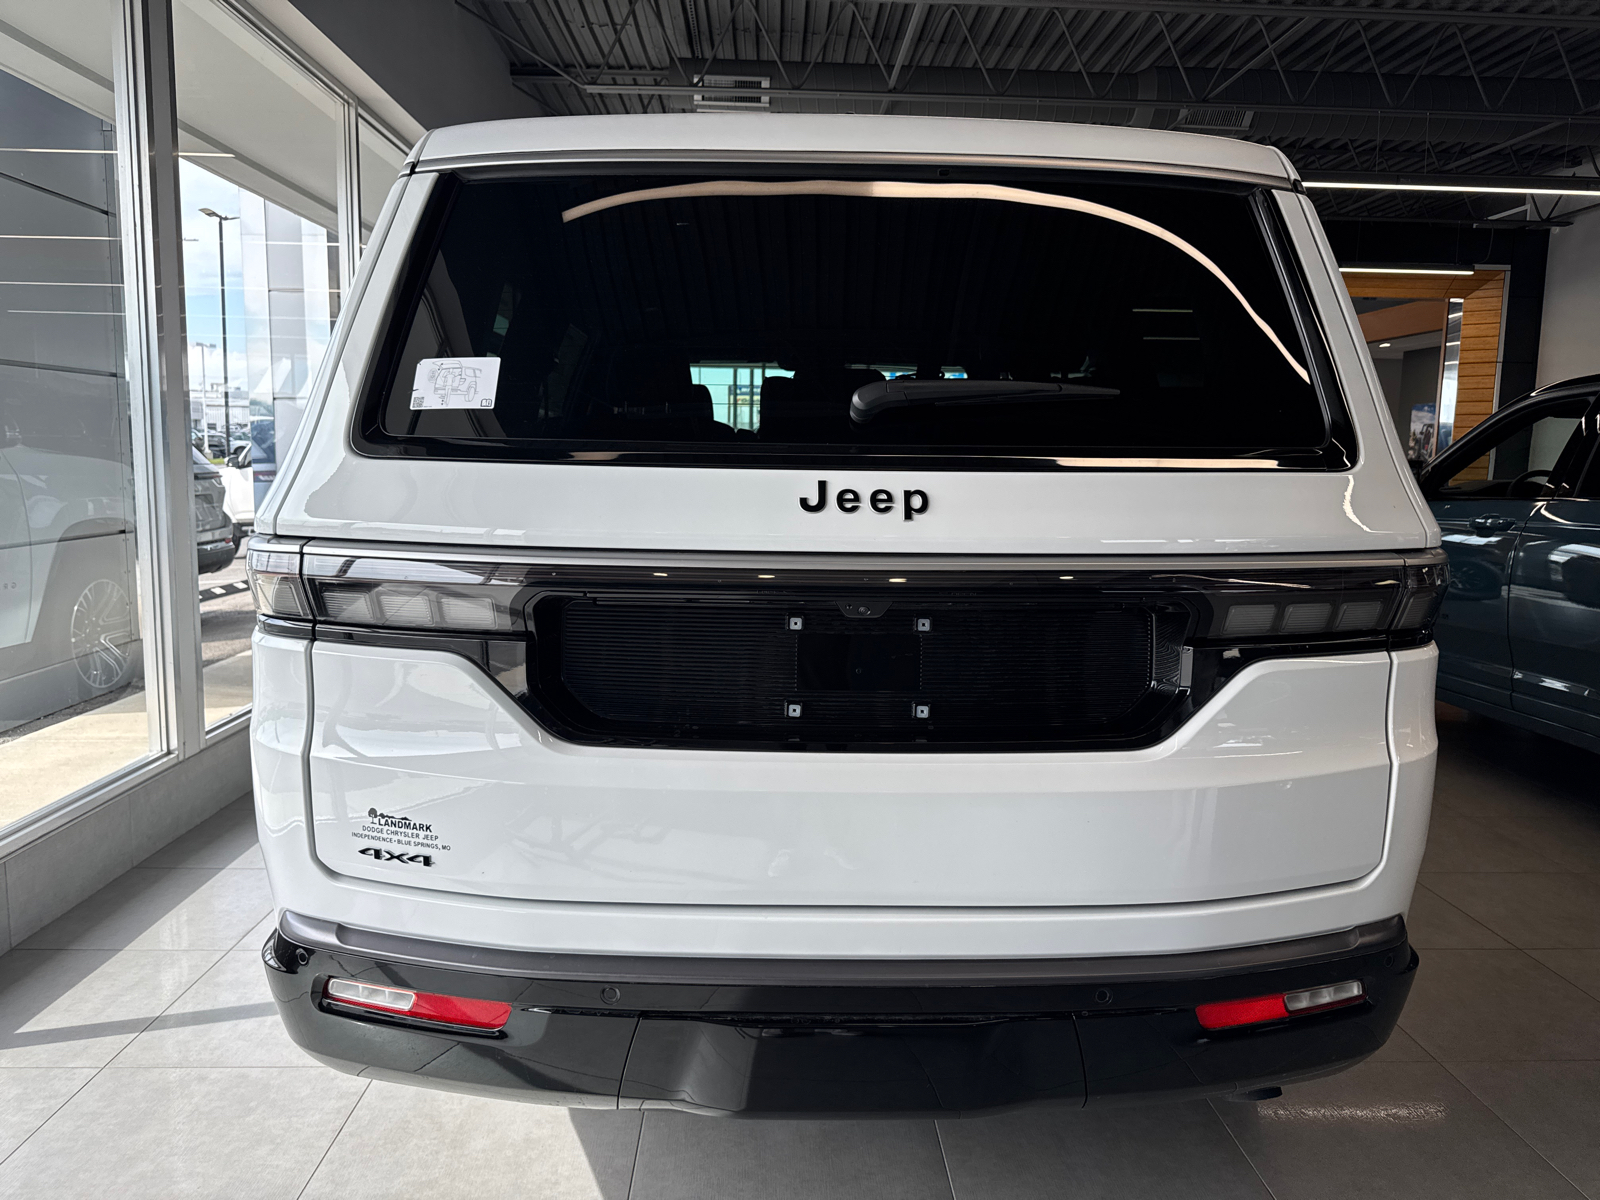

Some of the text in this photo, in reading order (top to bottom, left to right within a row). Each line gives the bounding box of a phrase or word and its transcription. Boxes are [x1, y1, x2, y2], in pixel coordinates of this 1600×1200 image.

[799, 479, 929, 521] Jeep
[362, 825, 439, 841] DODGE CHRYSLER JEEP
[378, 818, 433, 833] LANDMARK
[352, 832, 393, 843] INDEPENDENCE
